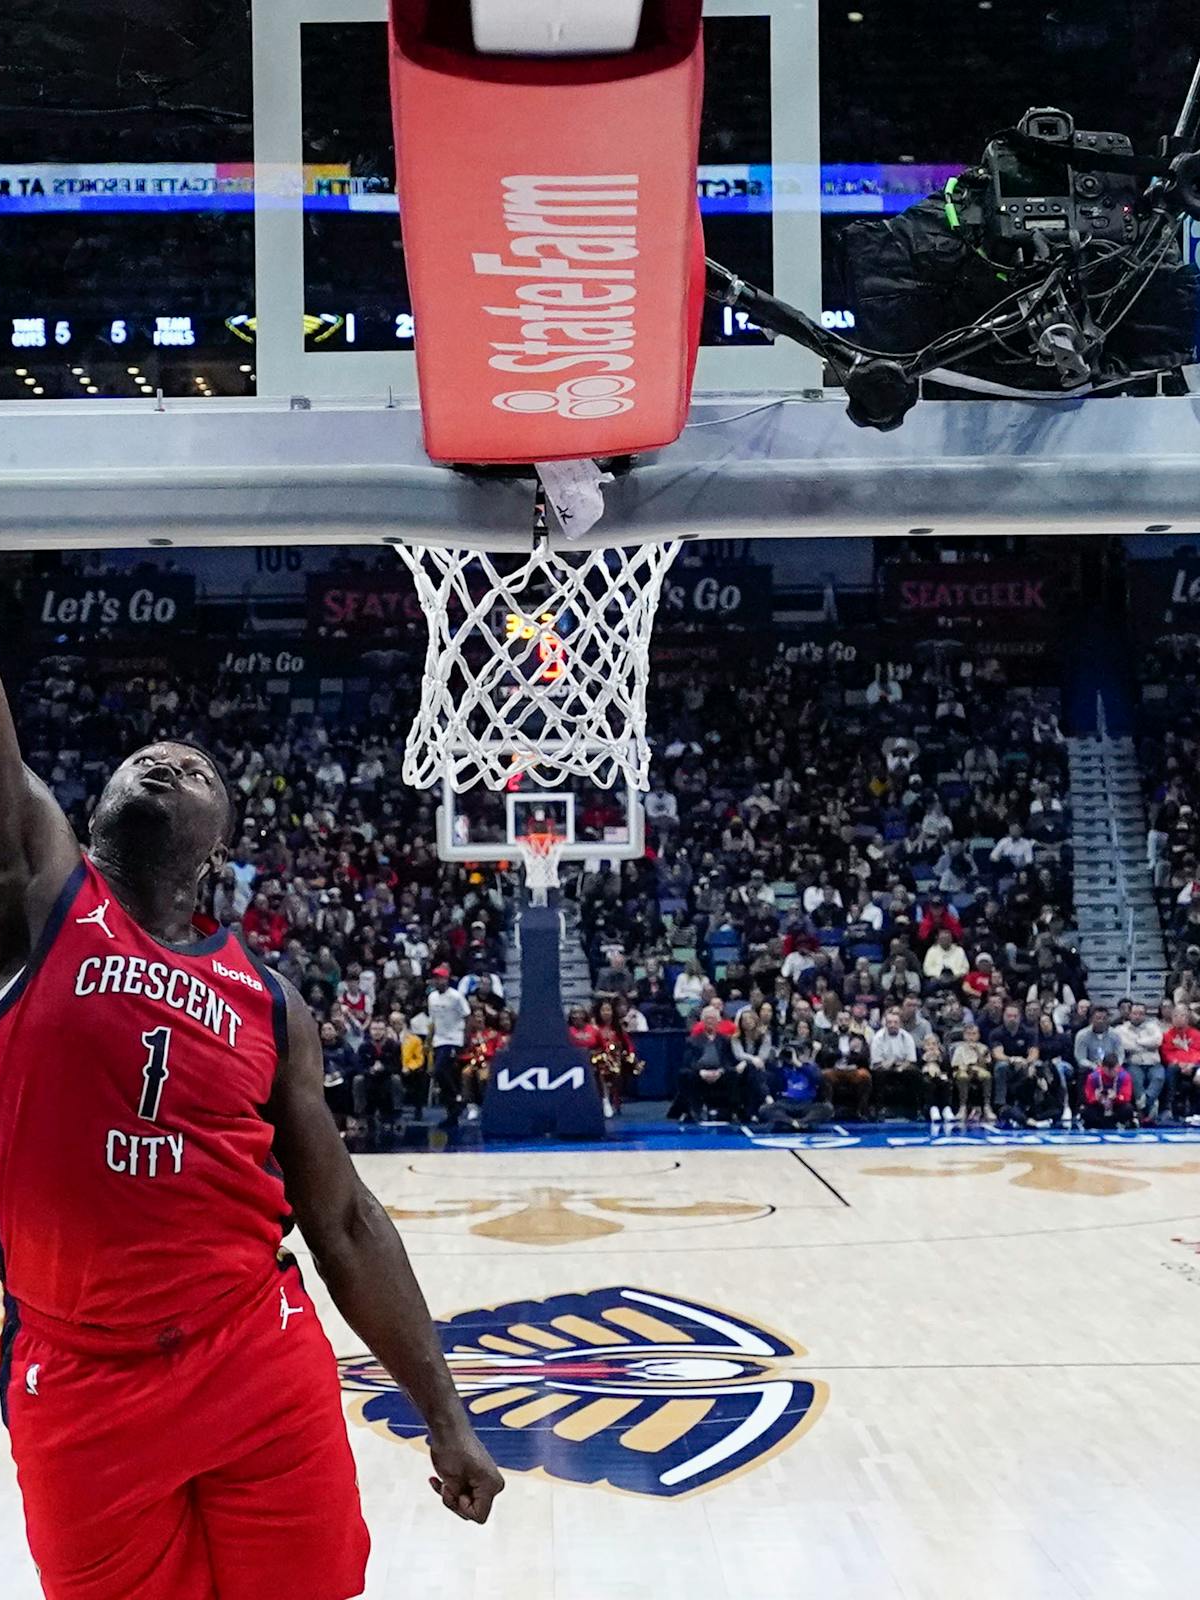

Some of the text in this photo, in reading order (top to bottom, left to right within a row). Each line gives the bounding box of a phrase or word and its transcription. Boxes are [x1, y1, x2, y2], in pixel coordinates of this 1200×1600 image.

[40, 588, 177, 624] Let's Go
[693, 577, 741, 612] Go
[74, 955, 242, 1048] CRESCENT
[138, 1025, 171, 1122] 1
[106, 1129, 184, 1177] CITY
